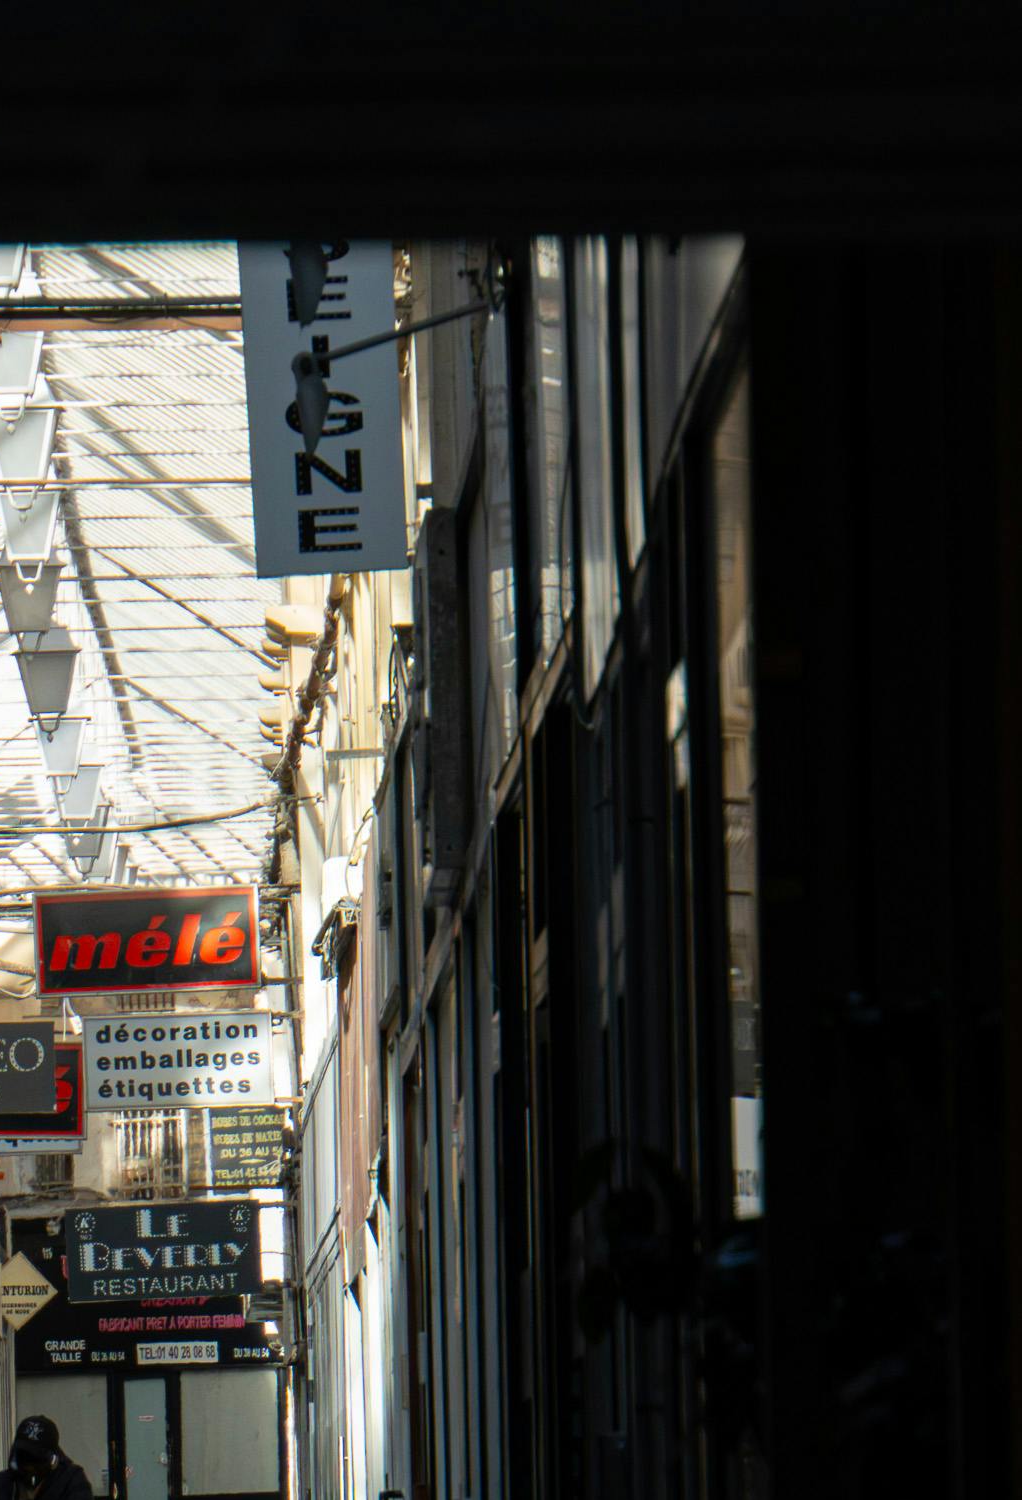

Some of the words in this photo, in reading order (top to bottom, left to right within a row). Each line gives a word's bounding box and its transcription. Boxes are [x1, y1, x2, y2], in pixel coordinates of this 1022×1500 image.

[49, 911, 246, 972] mélé
[95, 1021, 259, 1044] décoration
[96, 1048, 261, 1071] emballages
[97, 1077, 252, 1101] étiquettes
[93, 1273, 238, 1296] RESTAURANT
[98, 1317, 145, 1332] FABRICANT
[146, 1316, 166, 1331] PRET
[178, 1315, 211, 1330] PORTER
[44, 1340, 86, 1351] GRANDE
[50, 1351, 82, 1363] TAILLE
[168, 1345, 179, 1360] 40
[181, 1345, 191, 1359] 28
